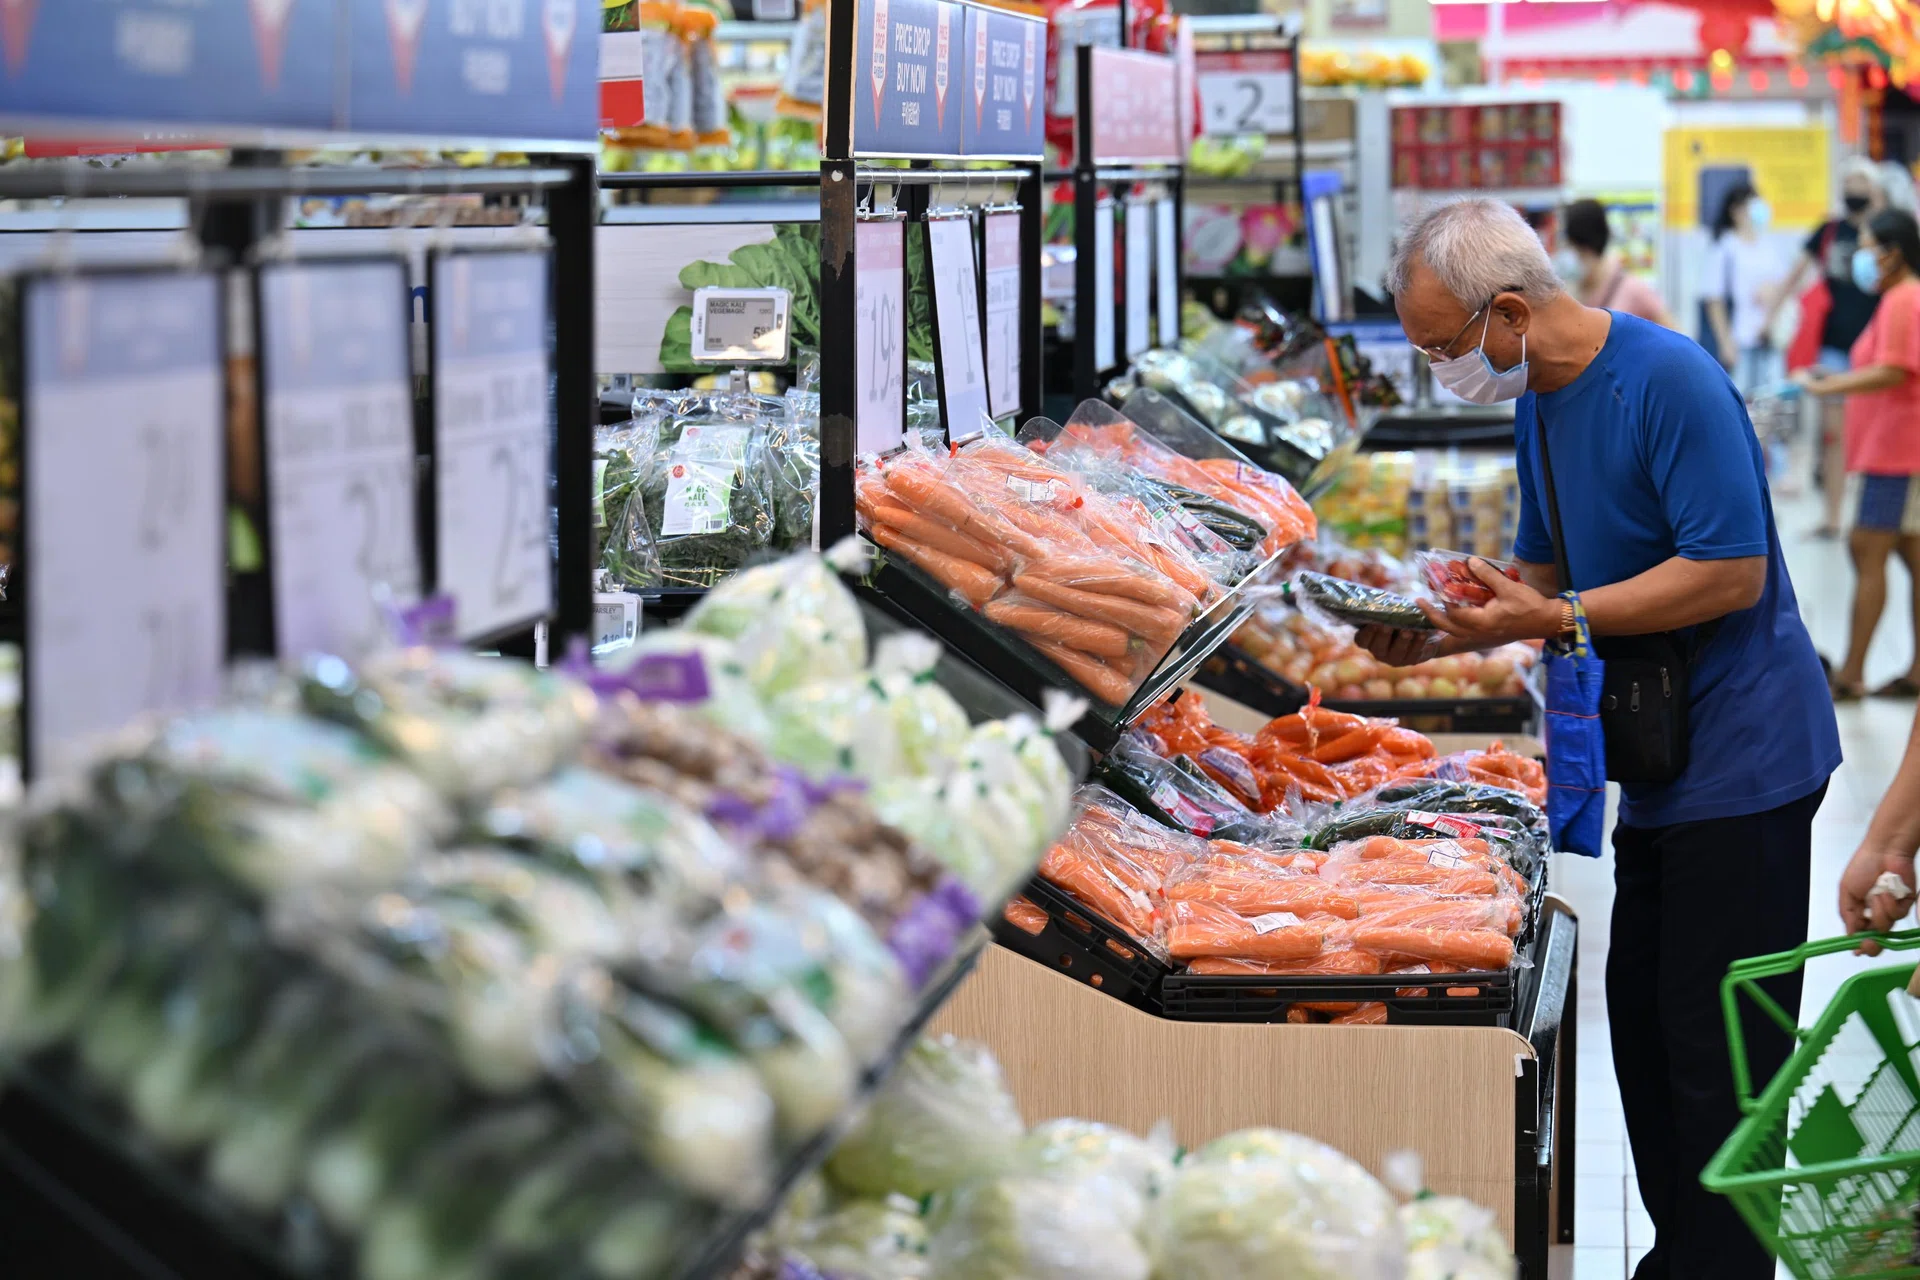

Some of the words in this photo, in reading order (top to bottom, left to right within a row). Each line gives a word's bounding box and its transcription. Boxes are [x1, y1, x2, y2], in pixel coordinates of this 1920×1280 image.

[895, 22, 912, 54] PRICE
[913, 26, 931, 57] DROP
[896, 62, 910, 93] BUY
[910, 64, 927, 95] NOW
